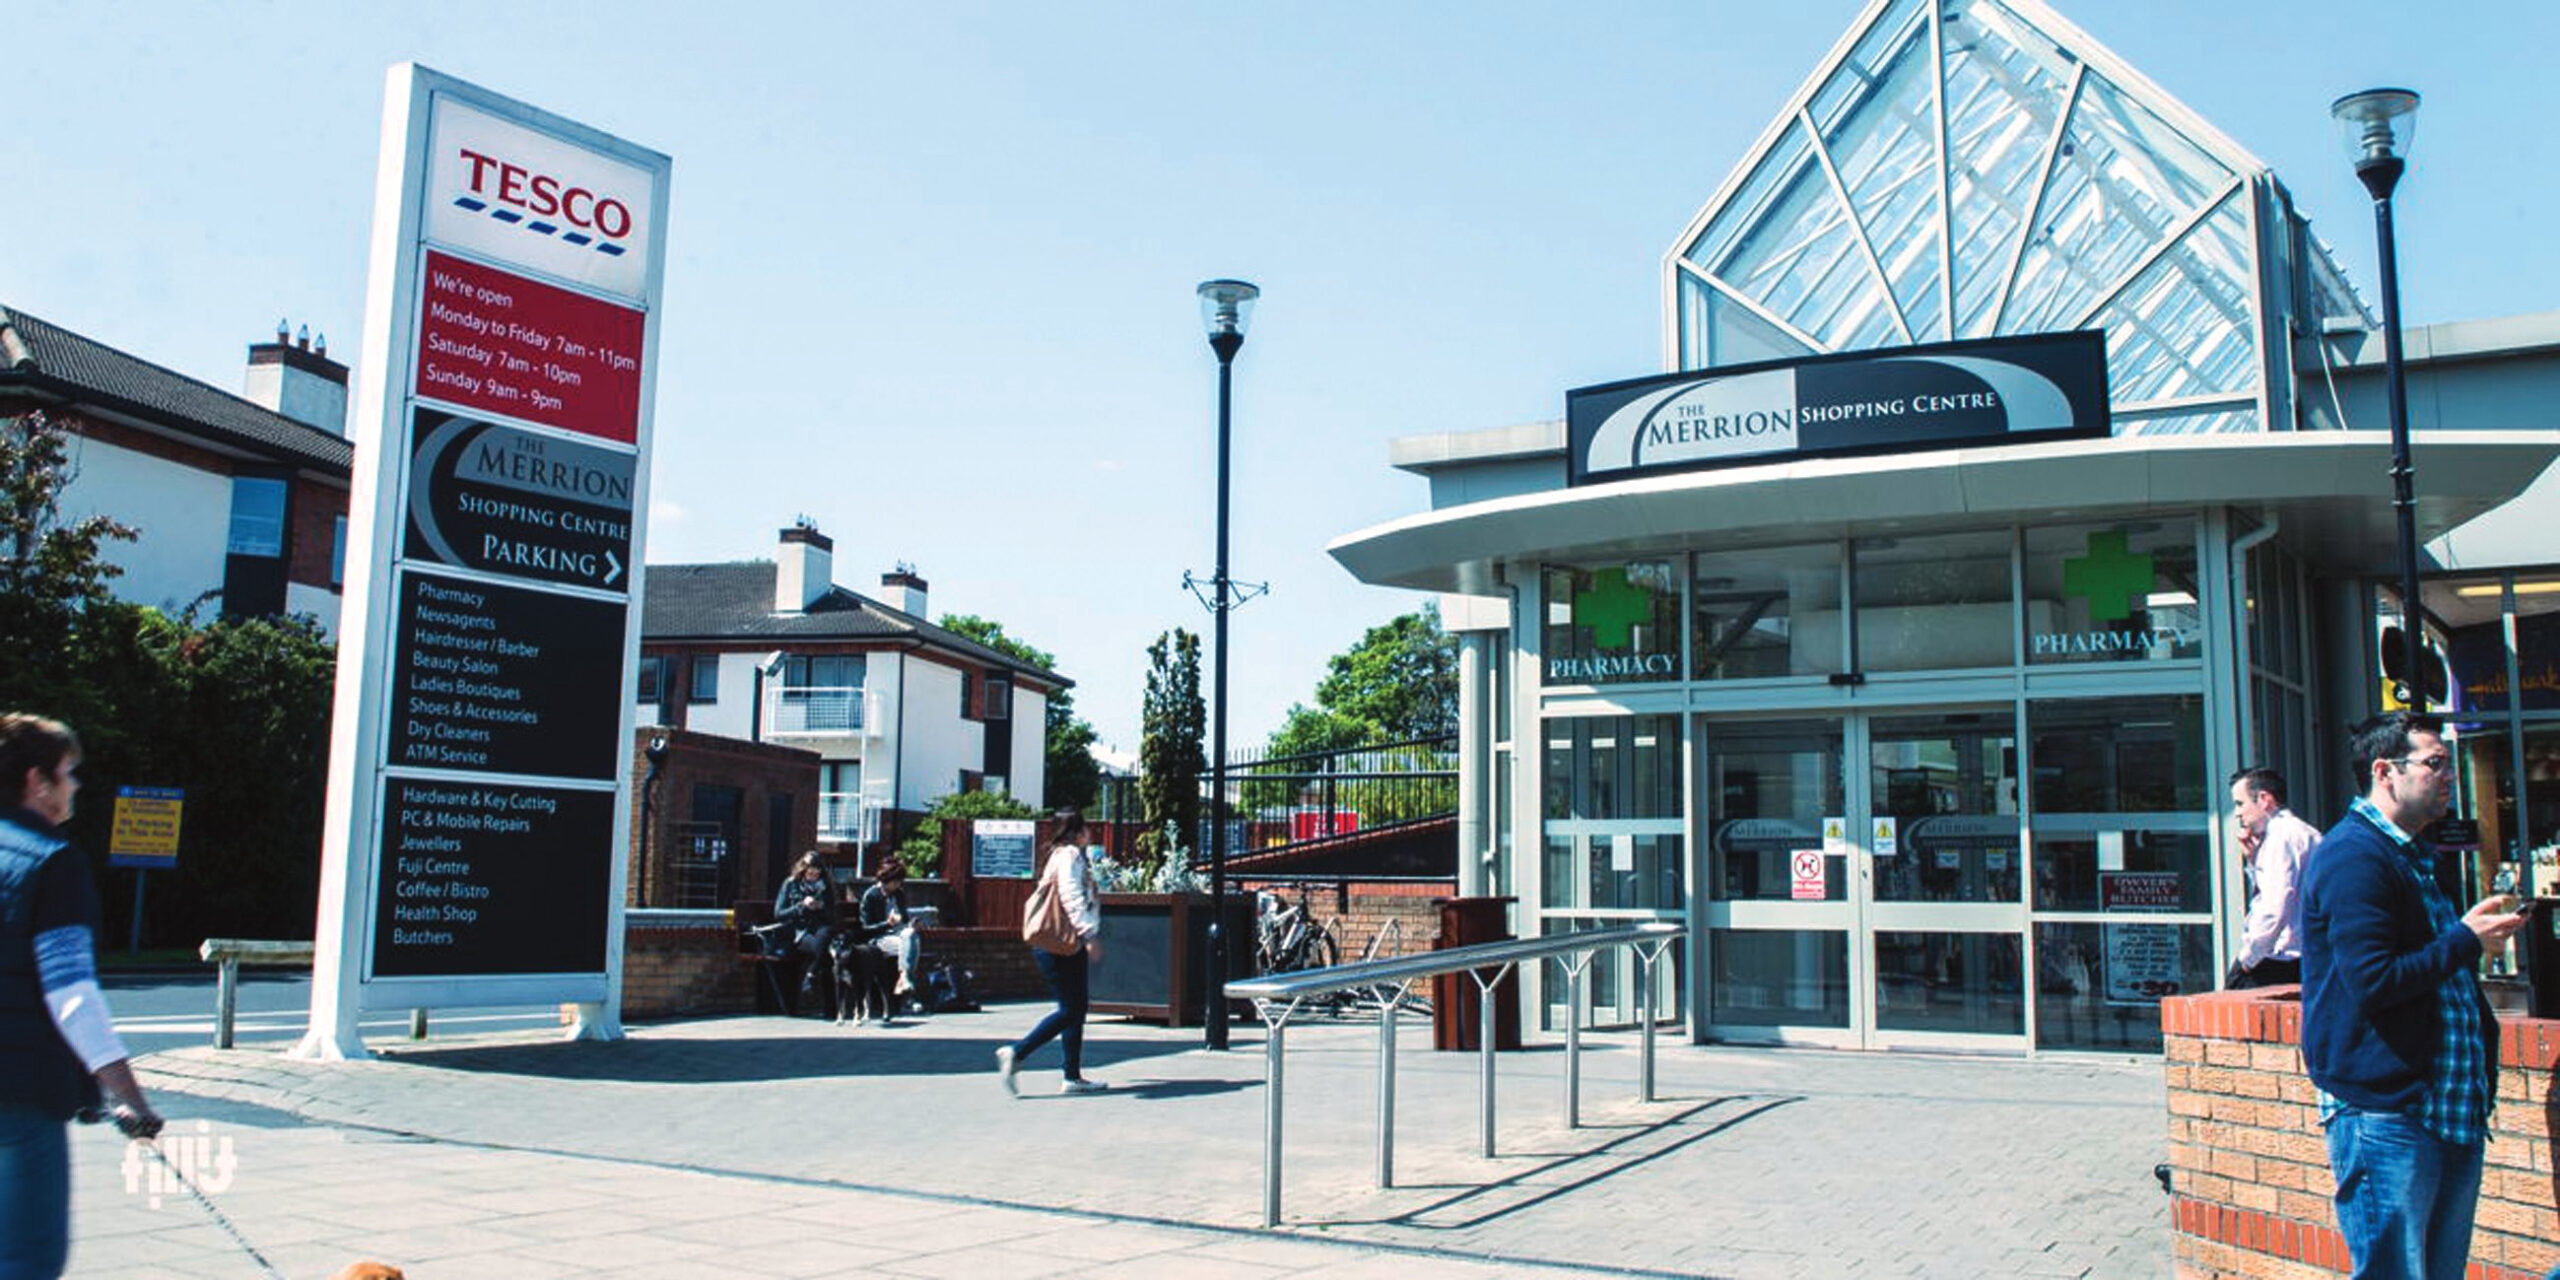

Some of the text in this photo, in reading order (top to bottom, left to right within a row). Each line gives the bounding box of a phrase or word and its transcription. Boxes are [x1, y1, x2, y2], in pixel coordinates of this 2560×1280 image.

[460, 148, 632, 239] TESCO
[434, 271, 513, 309] We're open
[431, 302, 489, 333] Monday
[491, 316, 506, 336] to
[509, 325, 550, 352] Friday
[557, 336, 586, 358] 7am
[599, 347, 636, 371] 11pm
[428, 332, 491, 367] Saturday
[498, 351, 530, 374] 7am
[543, 362, 581, 386] 10pm
[426, 363, 480, 392] Sunday
[487, 377, 518, 400] 9am
[530, 388, 562, 411] 9pm
[1648, 390, 1997, 447] MERRION SHOPPING CENTRE
[1677, 403, 1706, 418] THE
[516, 435, 546, 454] THE
[477, 444, 630, 500] MERRION
[458, 492, 629, 541] SHOPPING CENTRE
[483, 534, 597, 577] PARKING
[418, 582, 486, 608] Pharmacy
[417, 605, 497, 631] Newsagents
[415, 628, 489, 652] Hairdresser
[497, 639, 540, 658] Barber
[2033, 627, 2189, 655] PHARMACY
[413, 651, 499, 675] Beauty Salon
[1549, 652, 1677, 679] PHARMACY
[411, 674, 521, 702] Ladies Boutiques
[409, 698, 539, 725] Shoes & Accessories
[408, 720, 490, 743] Dry Cleaners
[406, 743, 487, 766] ATM Service
[403, 786, 556, 813] Hardware & Key Cutting
[401, 810, 531, 834] PC & Mobile Repairs
[400, 834, 462, 852] Jewellers
[398, 857, 470, 877] Fuji Centre
[396, 881, 442, 898] Coffee
[451, 882, 490, 900] Bistro
[394, 904, 478, 924] Health Shop
[392, 928, 454, 945] Butchers
